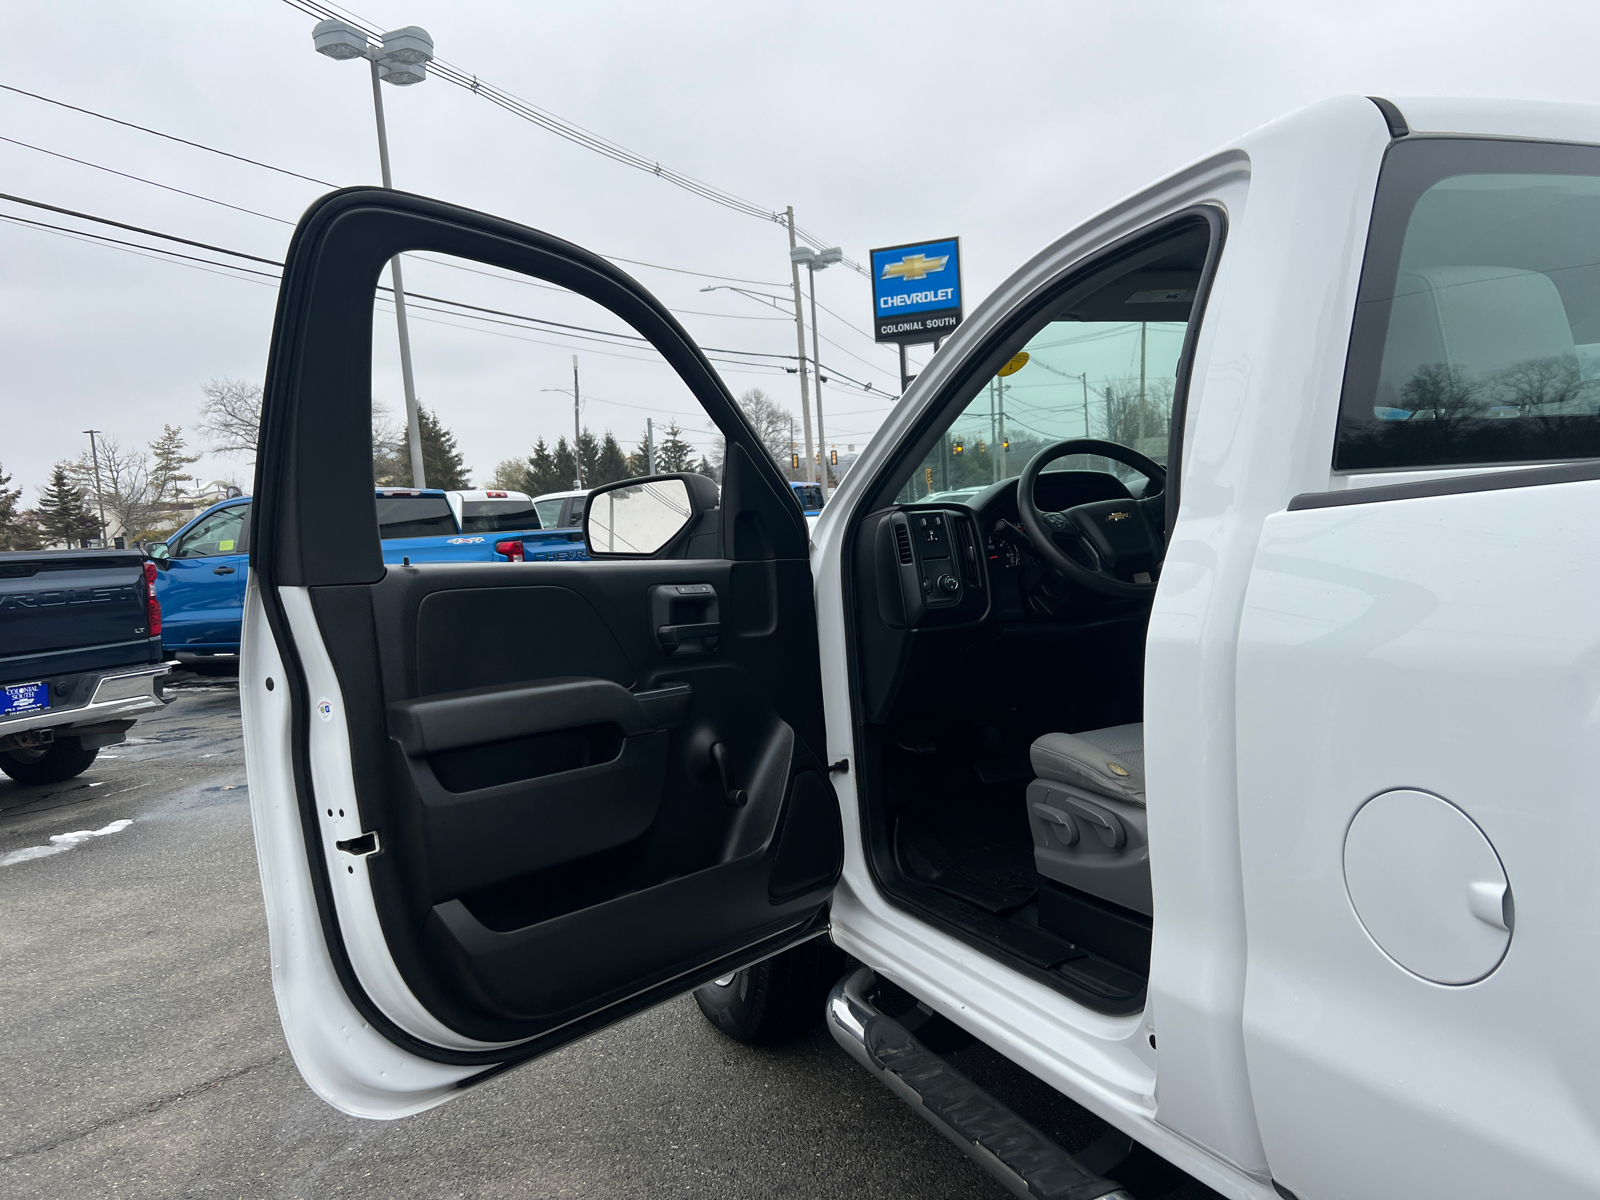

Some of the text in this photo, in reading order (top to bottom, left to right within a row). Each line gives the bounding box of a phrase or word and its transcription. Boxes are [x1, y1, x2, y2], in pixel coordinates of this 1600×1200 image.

[880, 288, 953, 308] CHEVROLET
[881, 316, 956, 334] COLONIAL SOUTH
[6, 686, 39, 696] COLONIAL
[11, 692, 35, 701] SOUTH
